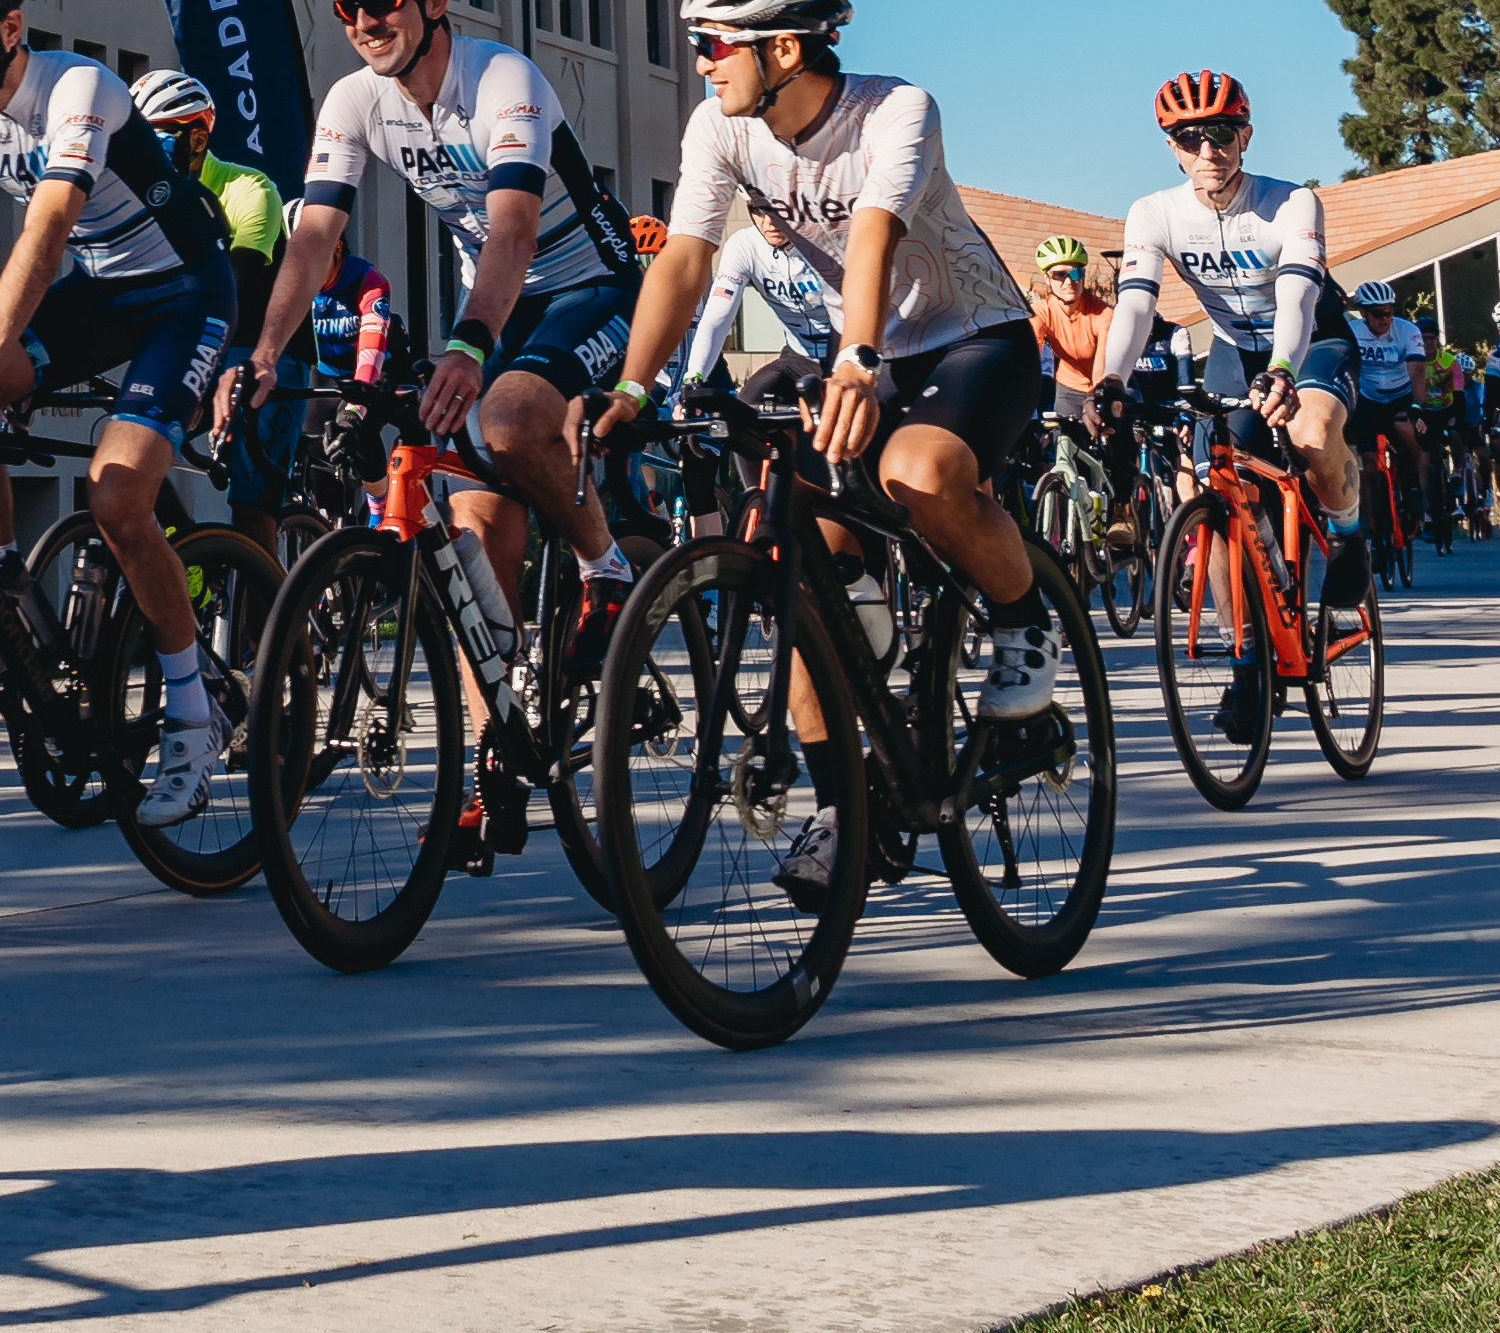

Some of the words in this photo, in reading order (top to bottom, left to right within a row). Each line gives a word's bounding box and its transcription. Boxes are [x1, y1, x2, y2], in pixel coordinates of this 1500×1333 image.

[400, 144, 459, 177] PAA
[591, 203, 628, 263] incycle
[1180, 250, 1238, 274] PAA
[762, 277, 804, 300] PAA
[573, 329, 618, 377] PAA
[1358, 345, 1386, 361] PAA
[181, 343, 217, 402] PAA
